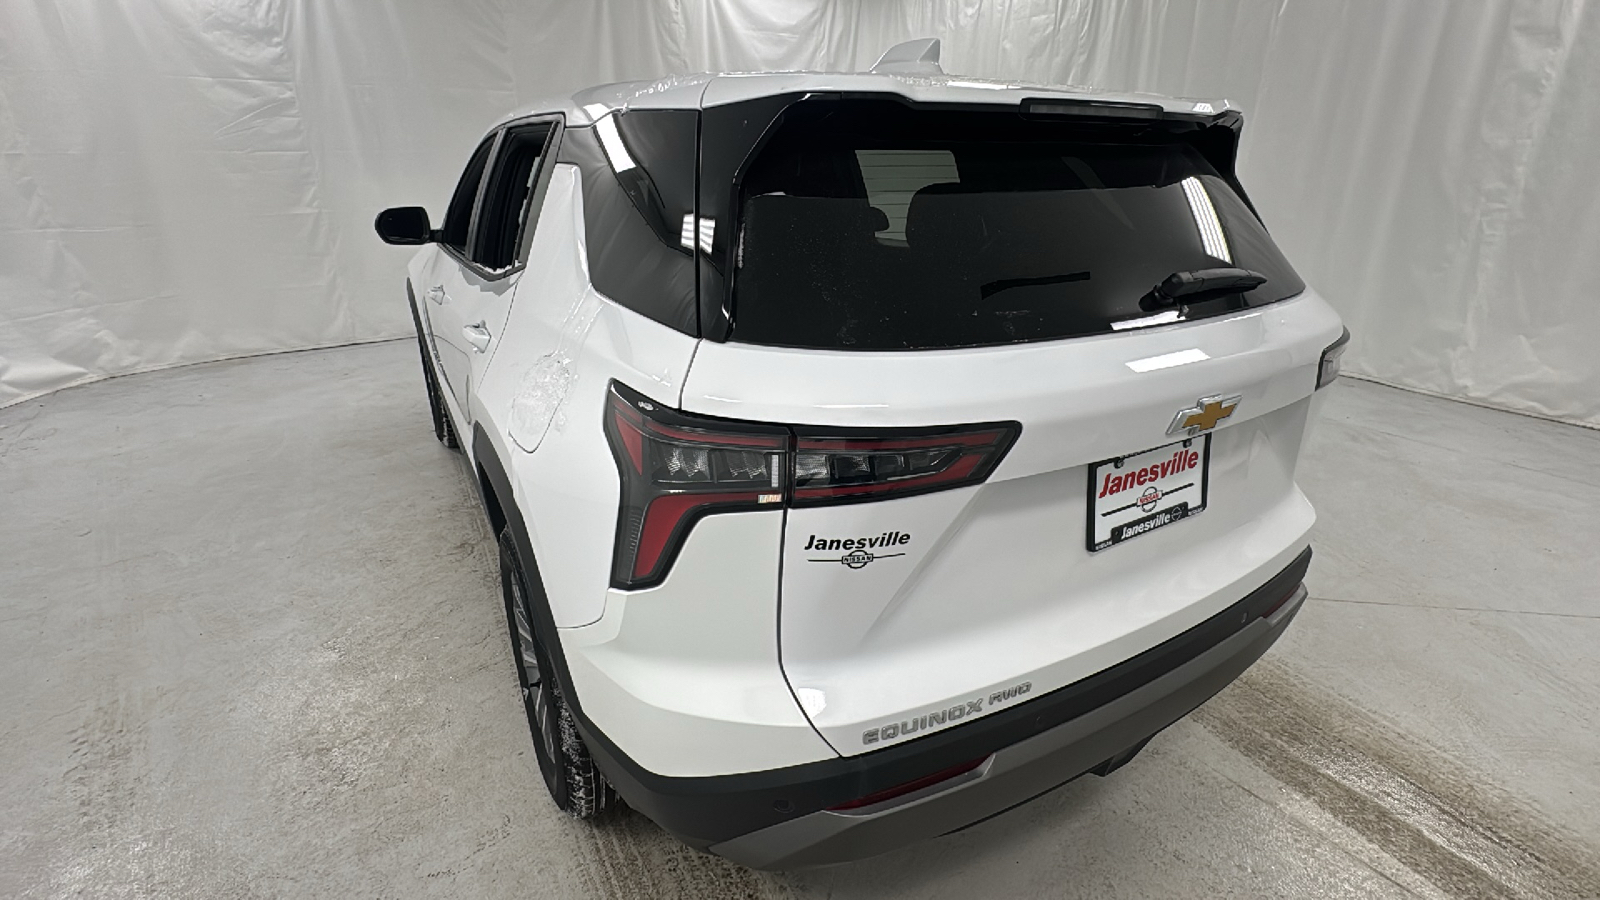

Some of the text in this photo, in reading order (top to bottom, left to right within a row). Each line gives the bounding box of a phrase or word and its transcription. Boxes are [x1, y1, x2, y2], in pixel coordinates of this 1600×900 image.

[1098, 448, 1199, 499] Janesville
[1121, 512, 1171, 540] Janesville
[804, 531, 911, 550] Janesville
[843, 555, 873, 563] NISSAN
[862, 681, 1032, 745] EQUINOX AWD
